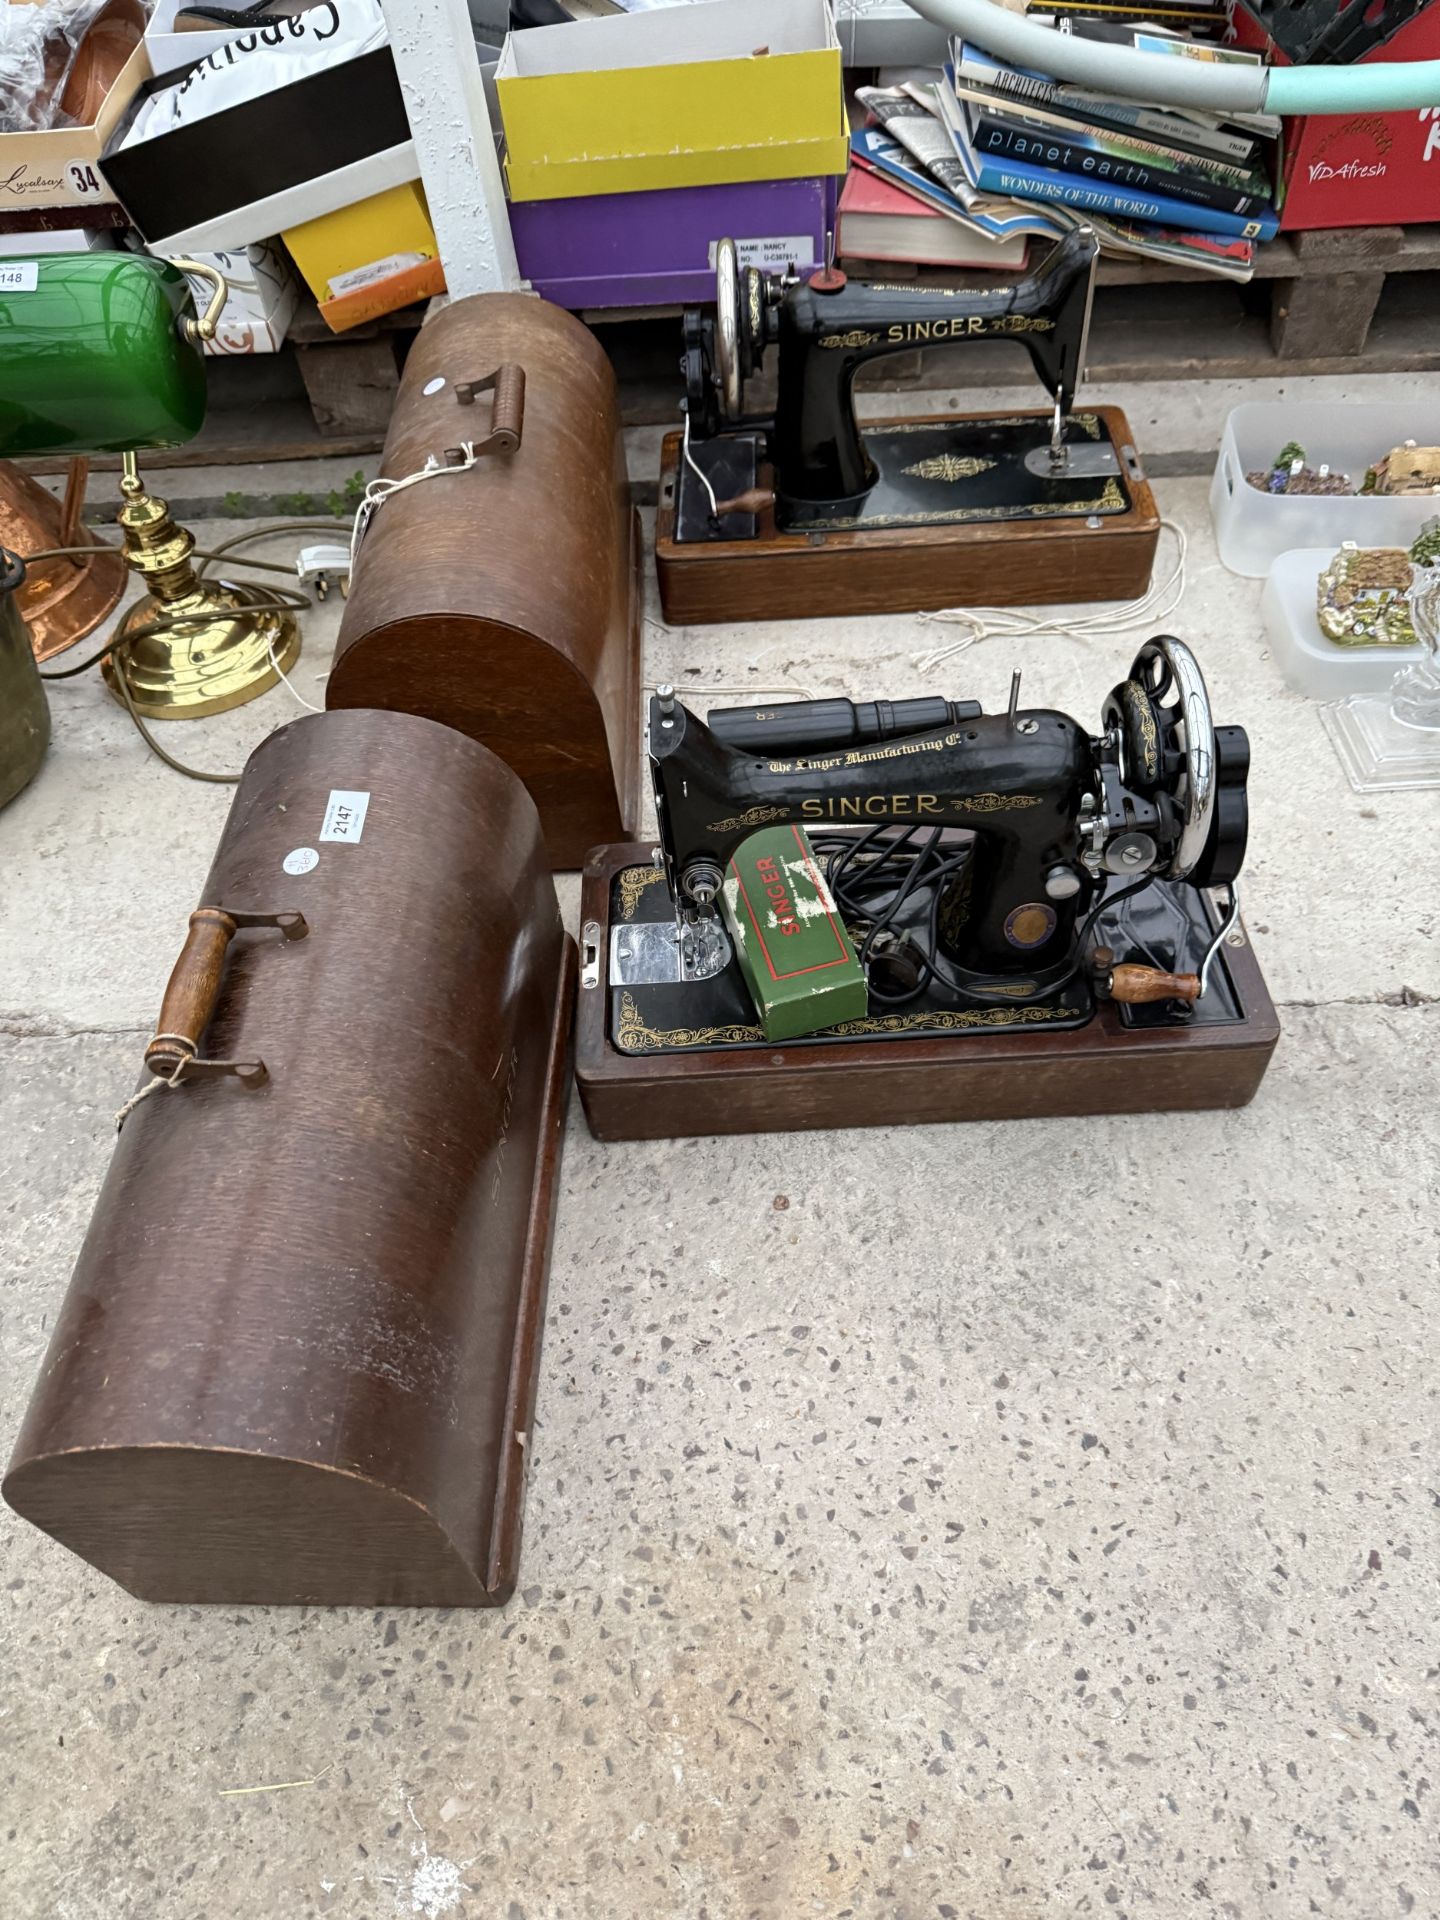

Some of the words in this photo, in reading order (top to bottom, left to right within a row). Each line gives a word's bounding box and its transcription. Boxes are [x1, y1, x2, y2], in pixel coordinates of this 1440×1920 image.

[988, 131, 1072, 165] planet
[1083, 157, 1149, 185] earth
[70, 165, 99, 192] 34
[1001, 174, 1063, 197] WONDERS
[1064, 188, 1084, 202] OF
[1085, 191, 1112, 208] THE
[1114, 198, 1159, 217] WORLD
[887, 316, 987, 343] SINGER
[767, 761, 791, 774] The
[795, 757, 842, 771] Singer
[844, 739, 943, 768] Manufacturing
[333, 805, 352, 835] 2147
[801, 794, 944, 818] SINGER
[756, 856, 800, 937] SINGER
